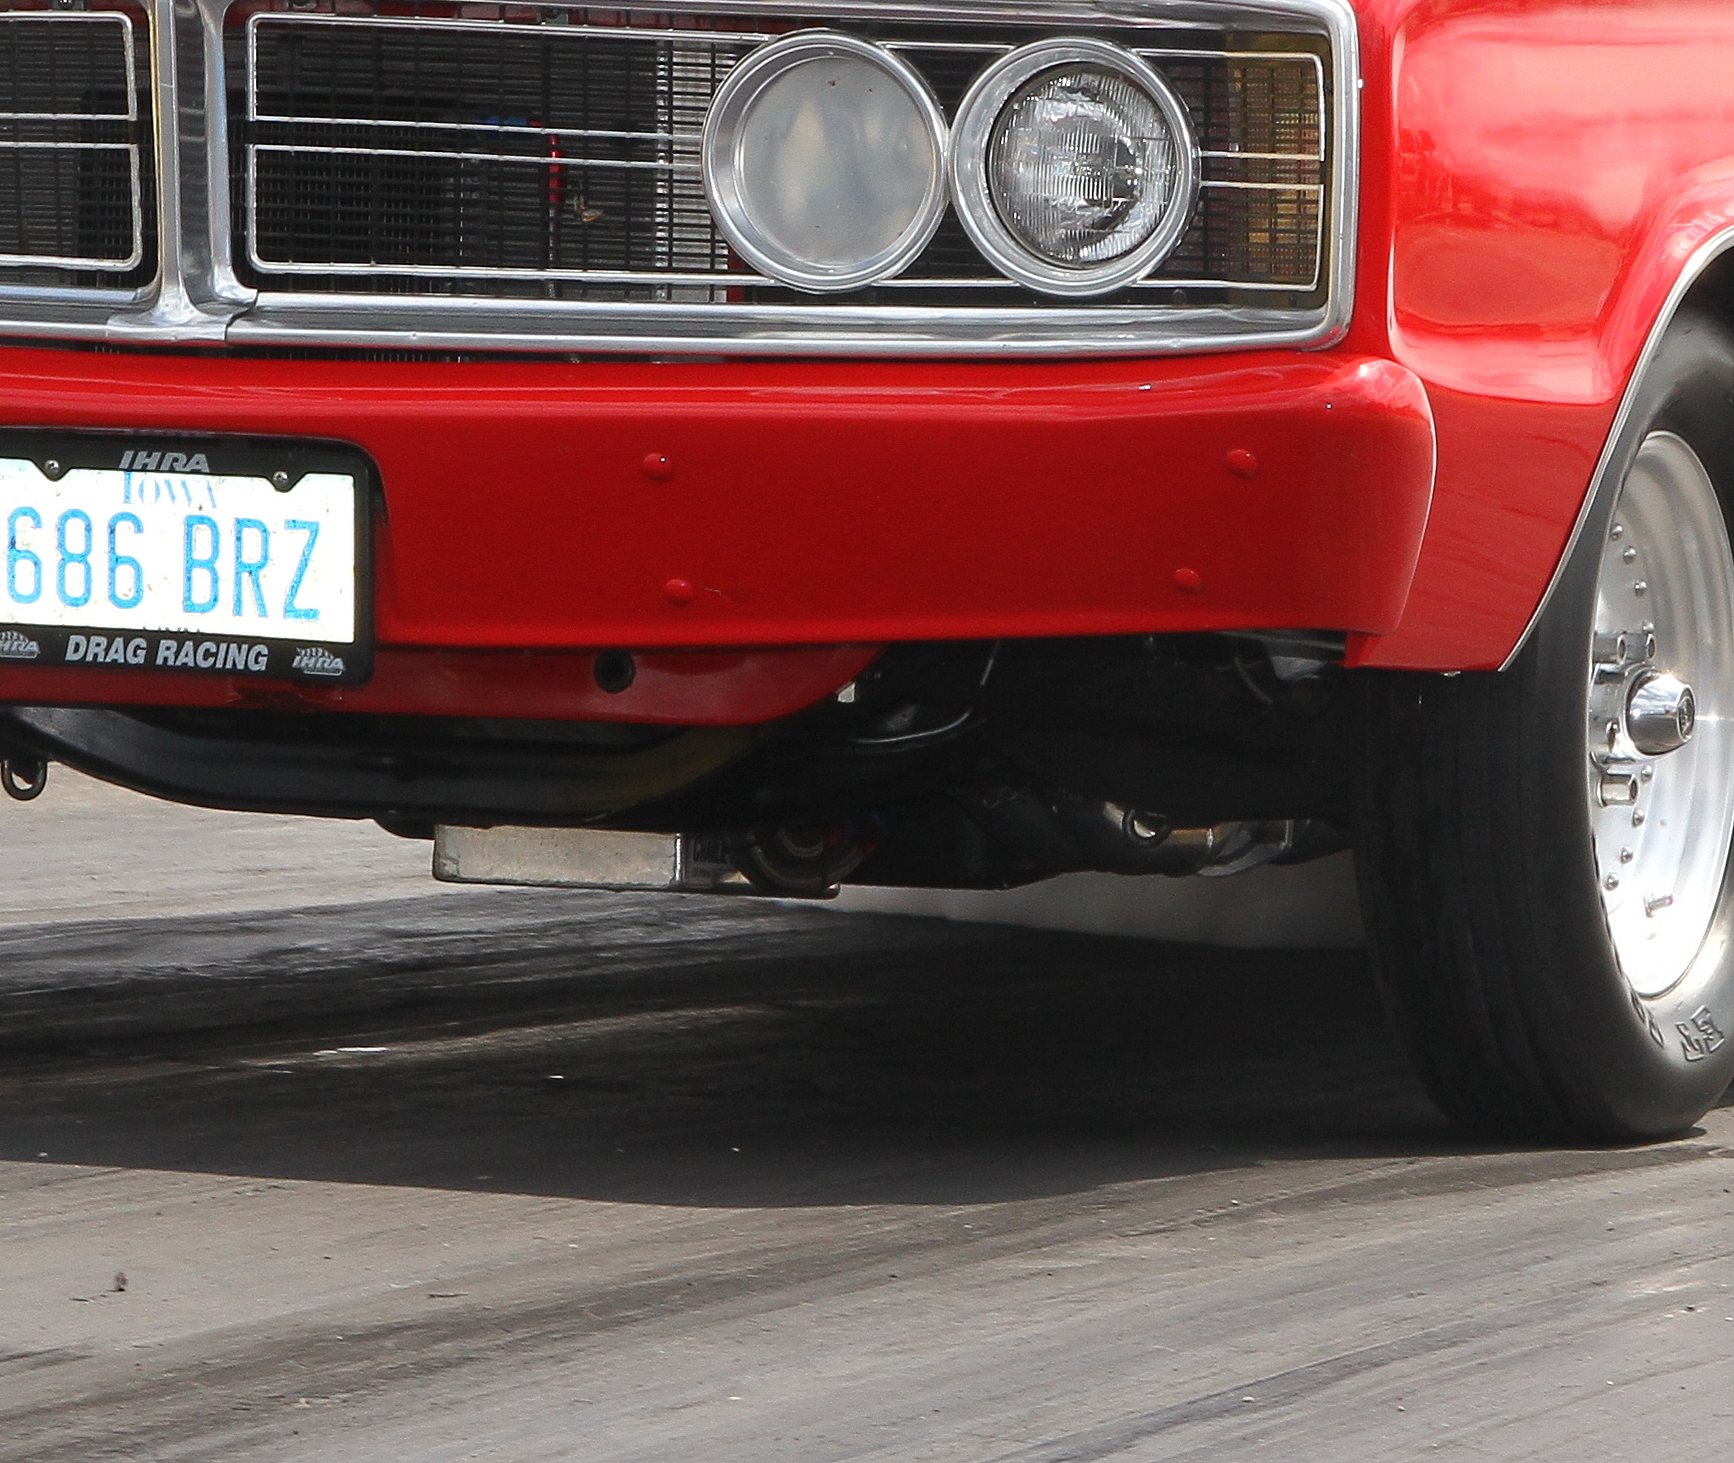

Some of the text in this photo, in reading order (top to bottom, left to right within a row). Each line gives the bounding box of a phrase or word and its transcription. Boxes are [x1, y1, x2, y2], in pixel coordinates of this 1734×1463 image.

[118, 450, 210, 473] IHRA
[6, 506, 320, 621] 686 BRZ
[65, 634, 269, 672] DRAG RACING
